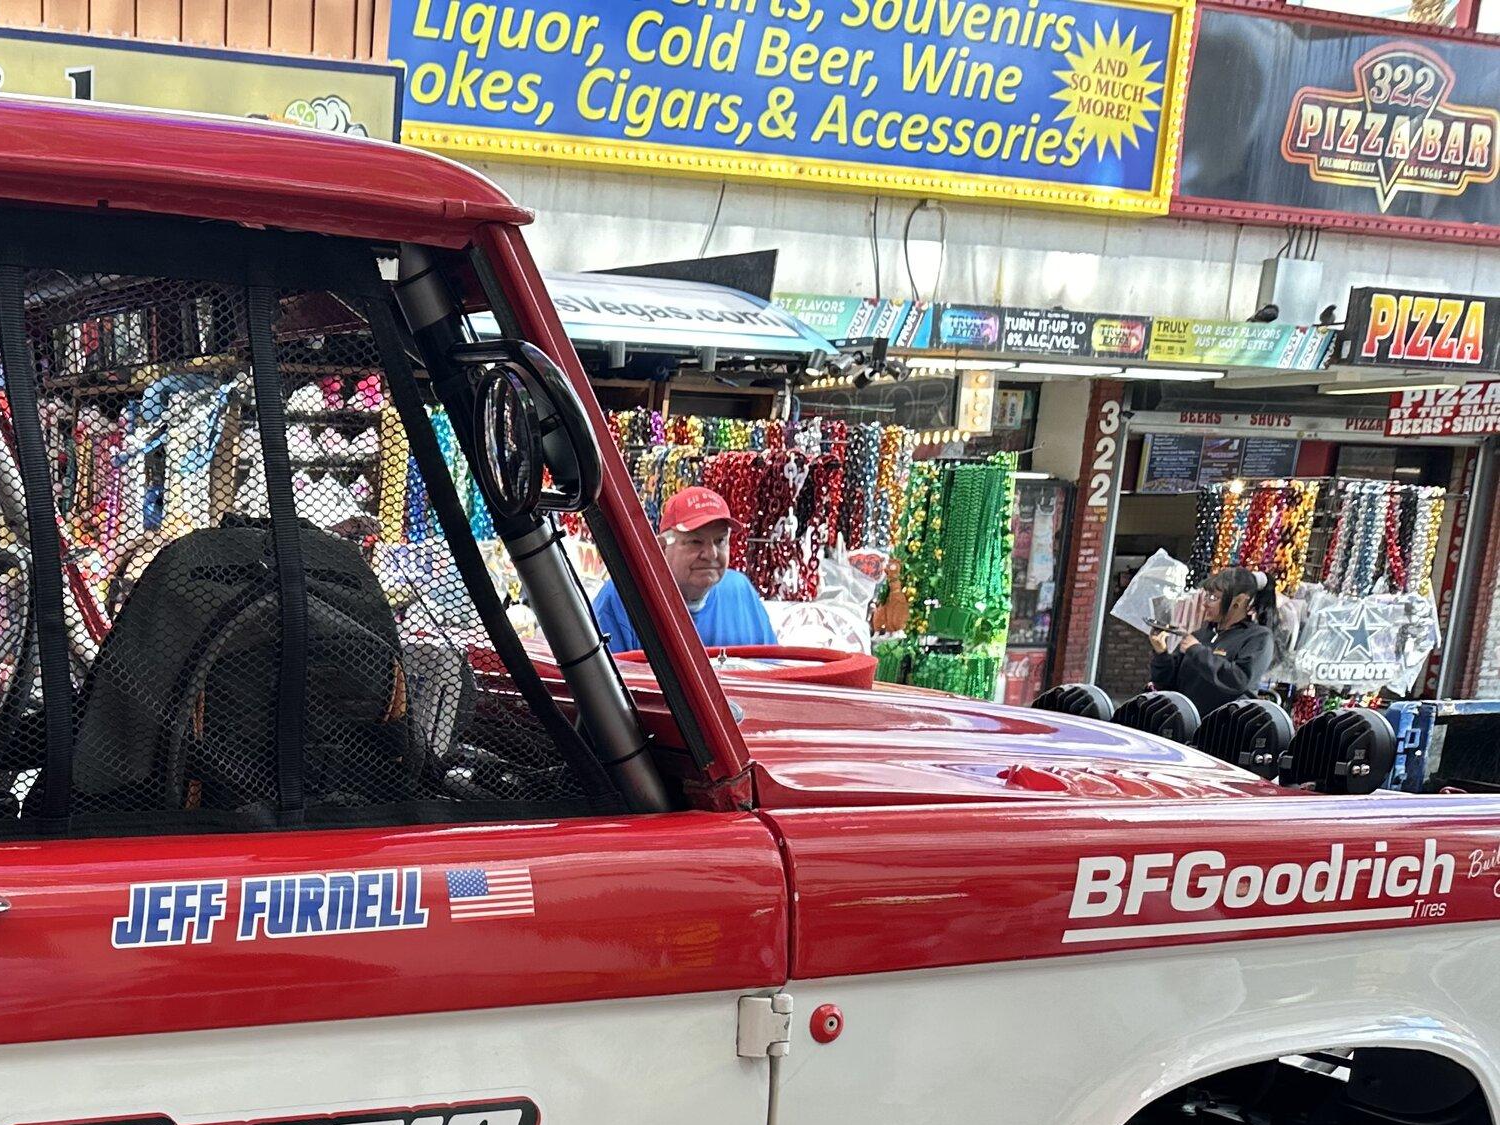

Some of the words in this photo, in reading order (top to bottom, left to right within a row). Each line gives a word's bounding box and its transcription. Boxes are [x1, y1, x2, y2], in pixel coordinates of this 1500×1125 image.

[412, 0, 608, 67] Liquor,
[626, 13, 741, 73] Cold
[755, 27, 879, 96] Beer,
[902, 45, 1022, 104] Wine
[1092, 55, 1128, 79] AND
[1070, 71, 1094, 92] SO
[1096, 72, 1146, 104] MUCH
[1369, 61, 1435, 109] 322
[388, 48, 555, 126] okes,
[576, 66, 757, 150] Cigars,
[759, 90, 798, 142] &
[810, 98, 1089, 168] Accessories
[1077, 94, 1132, 122] MORE!
[1297, 103, 1417, 161] PIZZA
[1417, 117, 1493, 168] BAR
[1403, 165, 1419, 177] LAS
[850, 302, 869, 338] RULY
[875, 302, 894, 338] RULY
[1005, 316, 1034, 332] TURN
[1037, 318, 1050, 333] IT
[1051, 320, 1069, 334] UP
[1071, 321, 1087, 335] TO
[1156, 320, 1189, 334] TRULY
[1192, 323, 1212, 335] OUR
[1361, 293, 1486, 364] PIZZA
[1219, 338, 1238, 350] GOT
[1400, 383, 1500, 408] PIZZA
[1179, 411, 1222, 424] BEERS
[1389, 407, 1414, 420] BY
[1417, 405, 1455, 418] THE
[1389, 417, 1444, 435] BEERS
[1088, 400, 1120, 507] 322
[1068, 838, 1456, 920] BFGoodrich
[111, 878, 228, 950] JEFF
[236, 867, 429, 942] FURNELL
[1413, 900, 1447, 918] Tires
